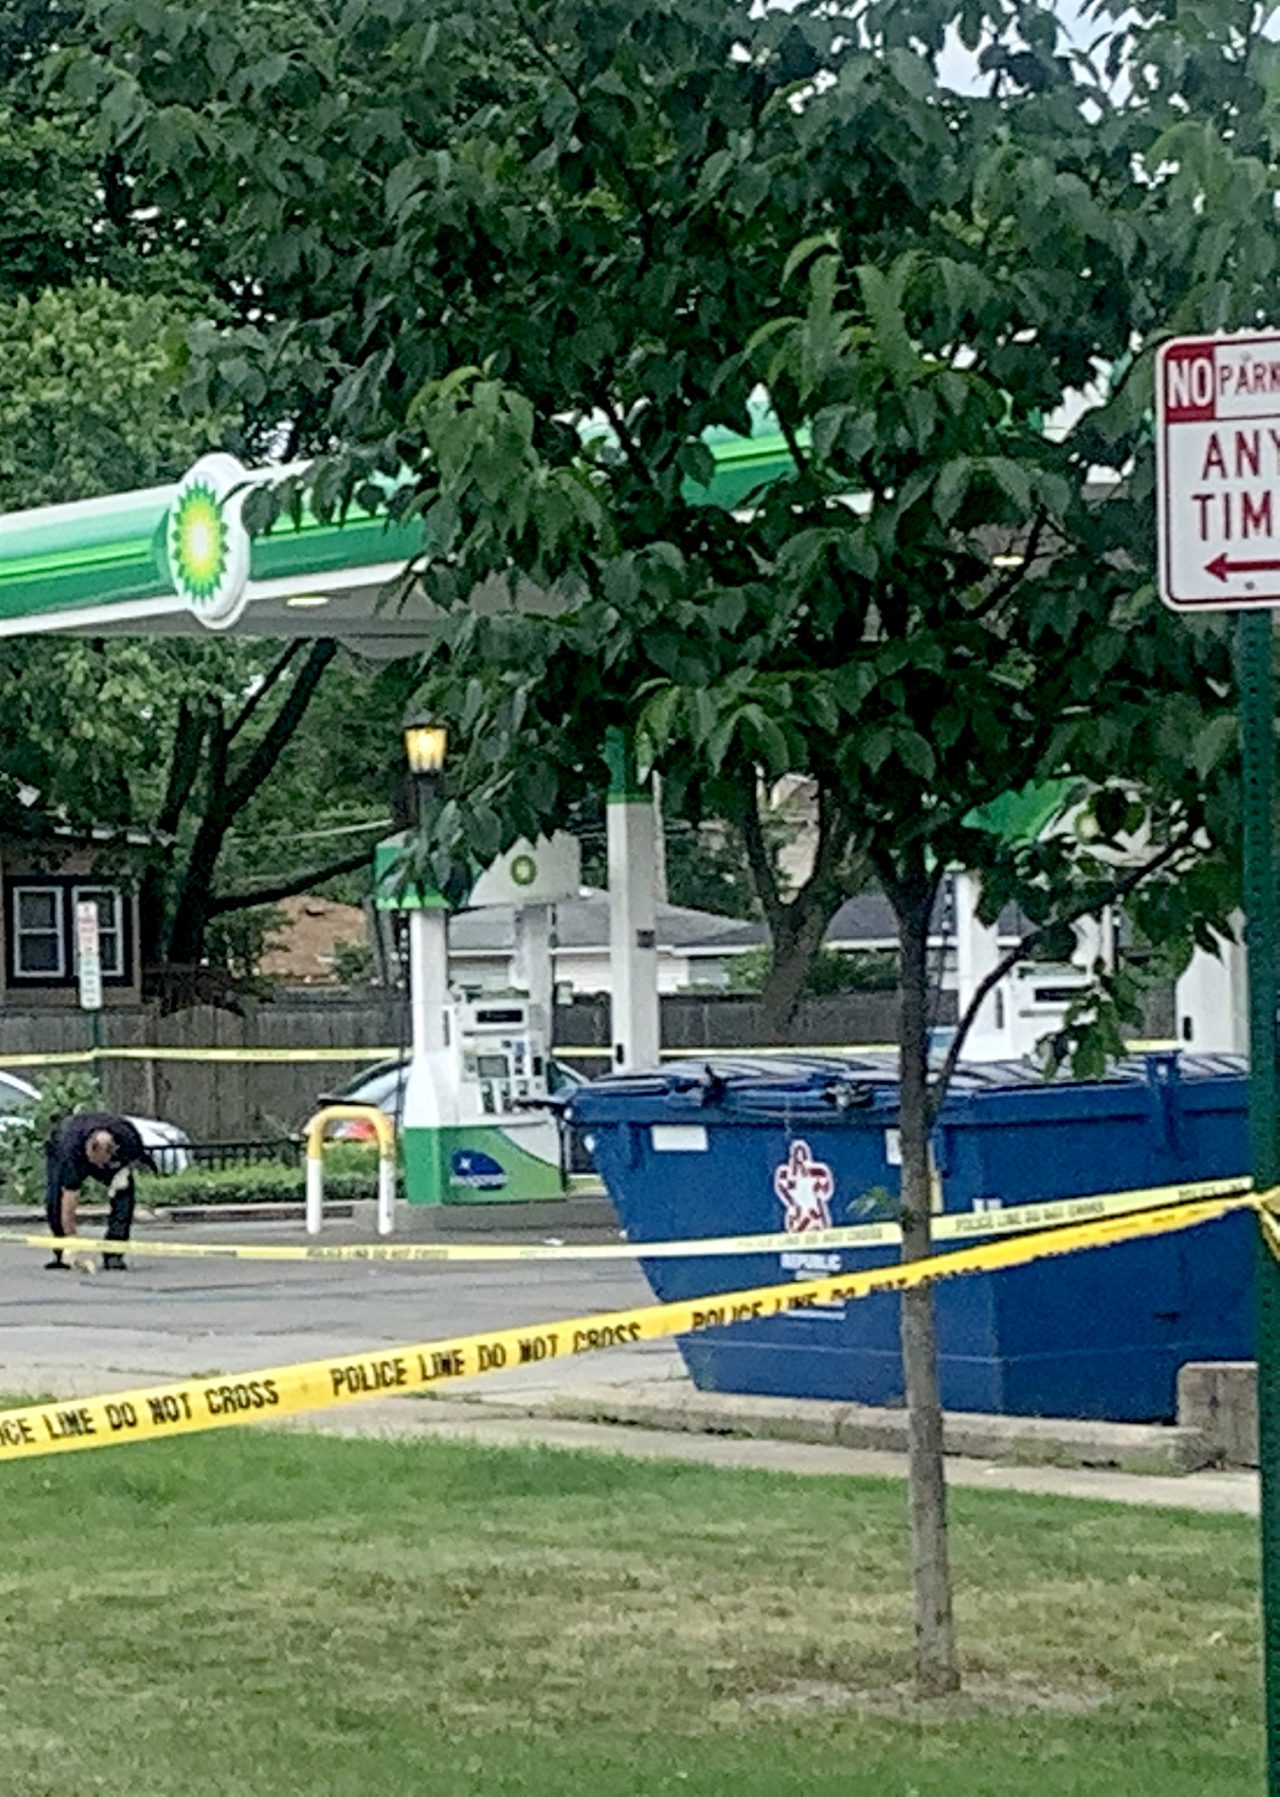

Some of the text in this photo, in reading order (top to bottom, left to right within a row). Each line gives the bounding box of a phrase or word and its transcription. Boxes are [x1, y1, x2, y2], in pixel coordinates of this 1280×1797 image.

[1167, 357, 1214, 409] NO
[329, 1321, 642, 1397] POLICE LINE DO NOT CROSS
[41, 1406, 99, 1440] LINE
[104, 1400, 138, 1432] DO
[149, 1392, 194, 1425] NOT
[203, 1378, 280, 1416] CROSS
